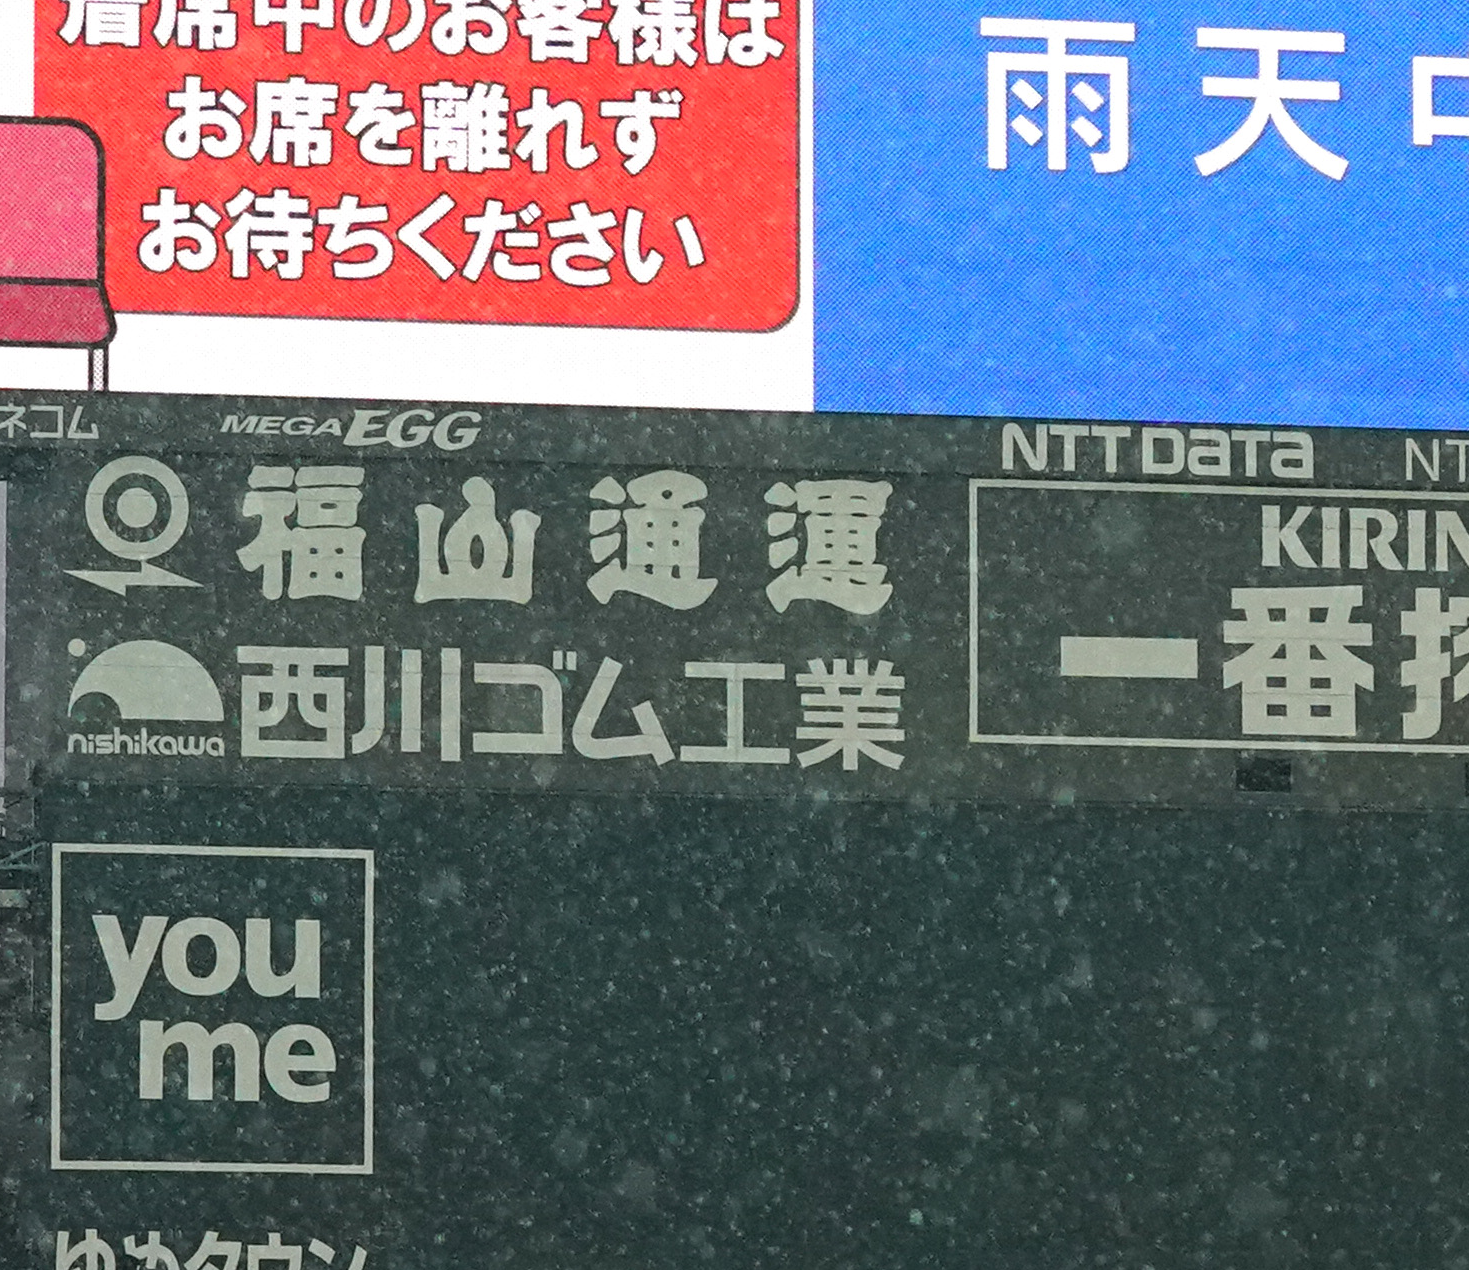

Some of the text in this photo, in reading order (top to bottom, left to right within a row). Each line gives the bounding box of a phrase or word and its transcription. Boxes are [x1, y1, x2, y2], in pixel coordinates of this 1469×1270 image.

[165, 75, 683, 177] お席を離れず
[138, 191, 705, 290] お待ちください
[235, 464, 894, 613] 福山通運
[66, 728, 225, 758] nishikawa
[237, 645, 906, 771] 西川ゴム工業
[92, 914, 321, 1021] you
[139, 1021, 336, 1103] me
